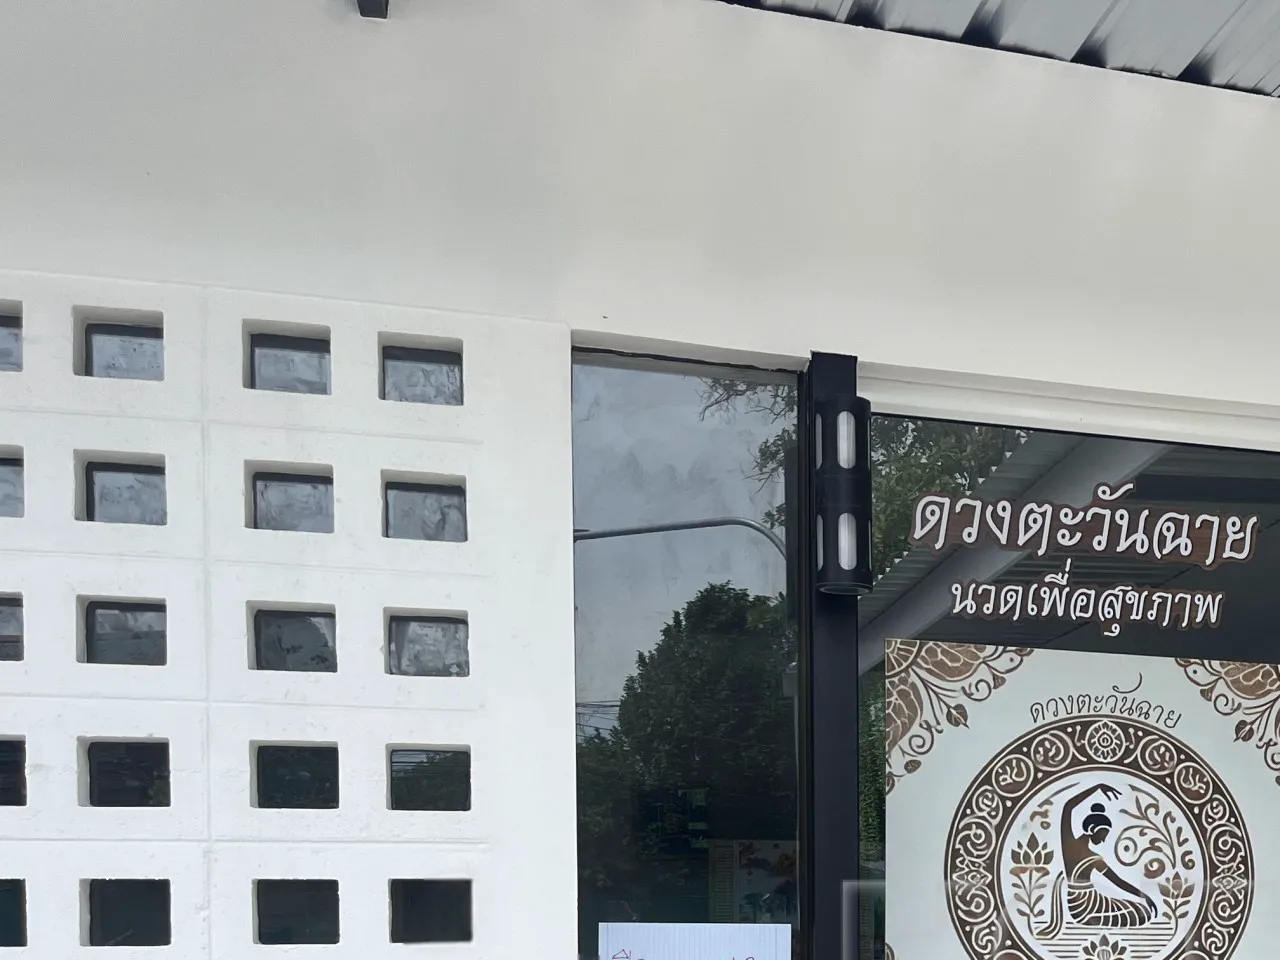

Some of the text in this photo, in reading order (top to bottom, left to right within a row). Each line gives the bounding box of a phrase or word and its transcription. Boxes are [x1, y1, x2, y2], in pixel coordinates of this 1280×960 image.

[913, 483, 1257, 566] ดวงตะวันฉาย
[952, 558, 1222, 636] นวดเพื่อสุขภาพ
[1030, 672, 1182, 728] ดวงตะวันฉาย
